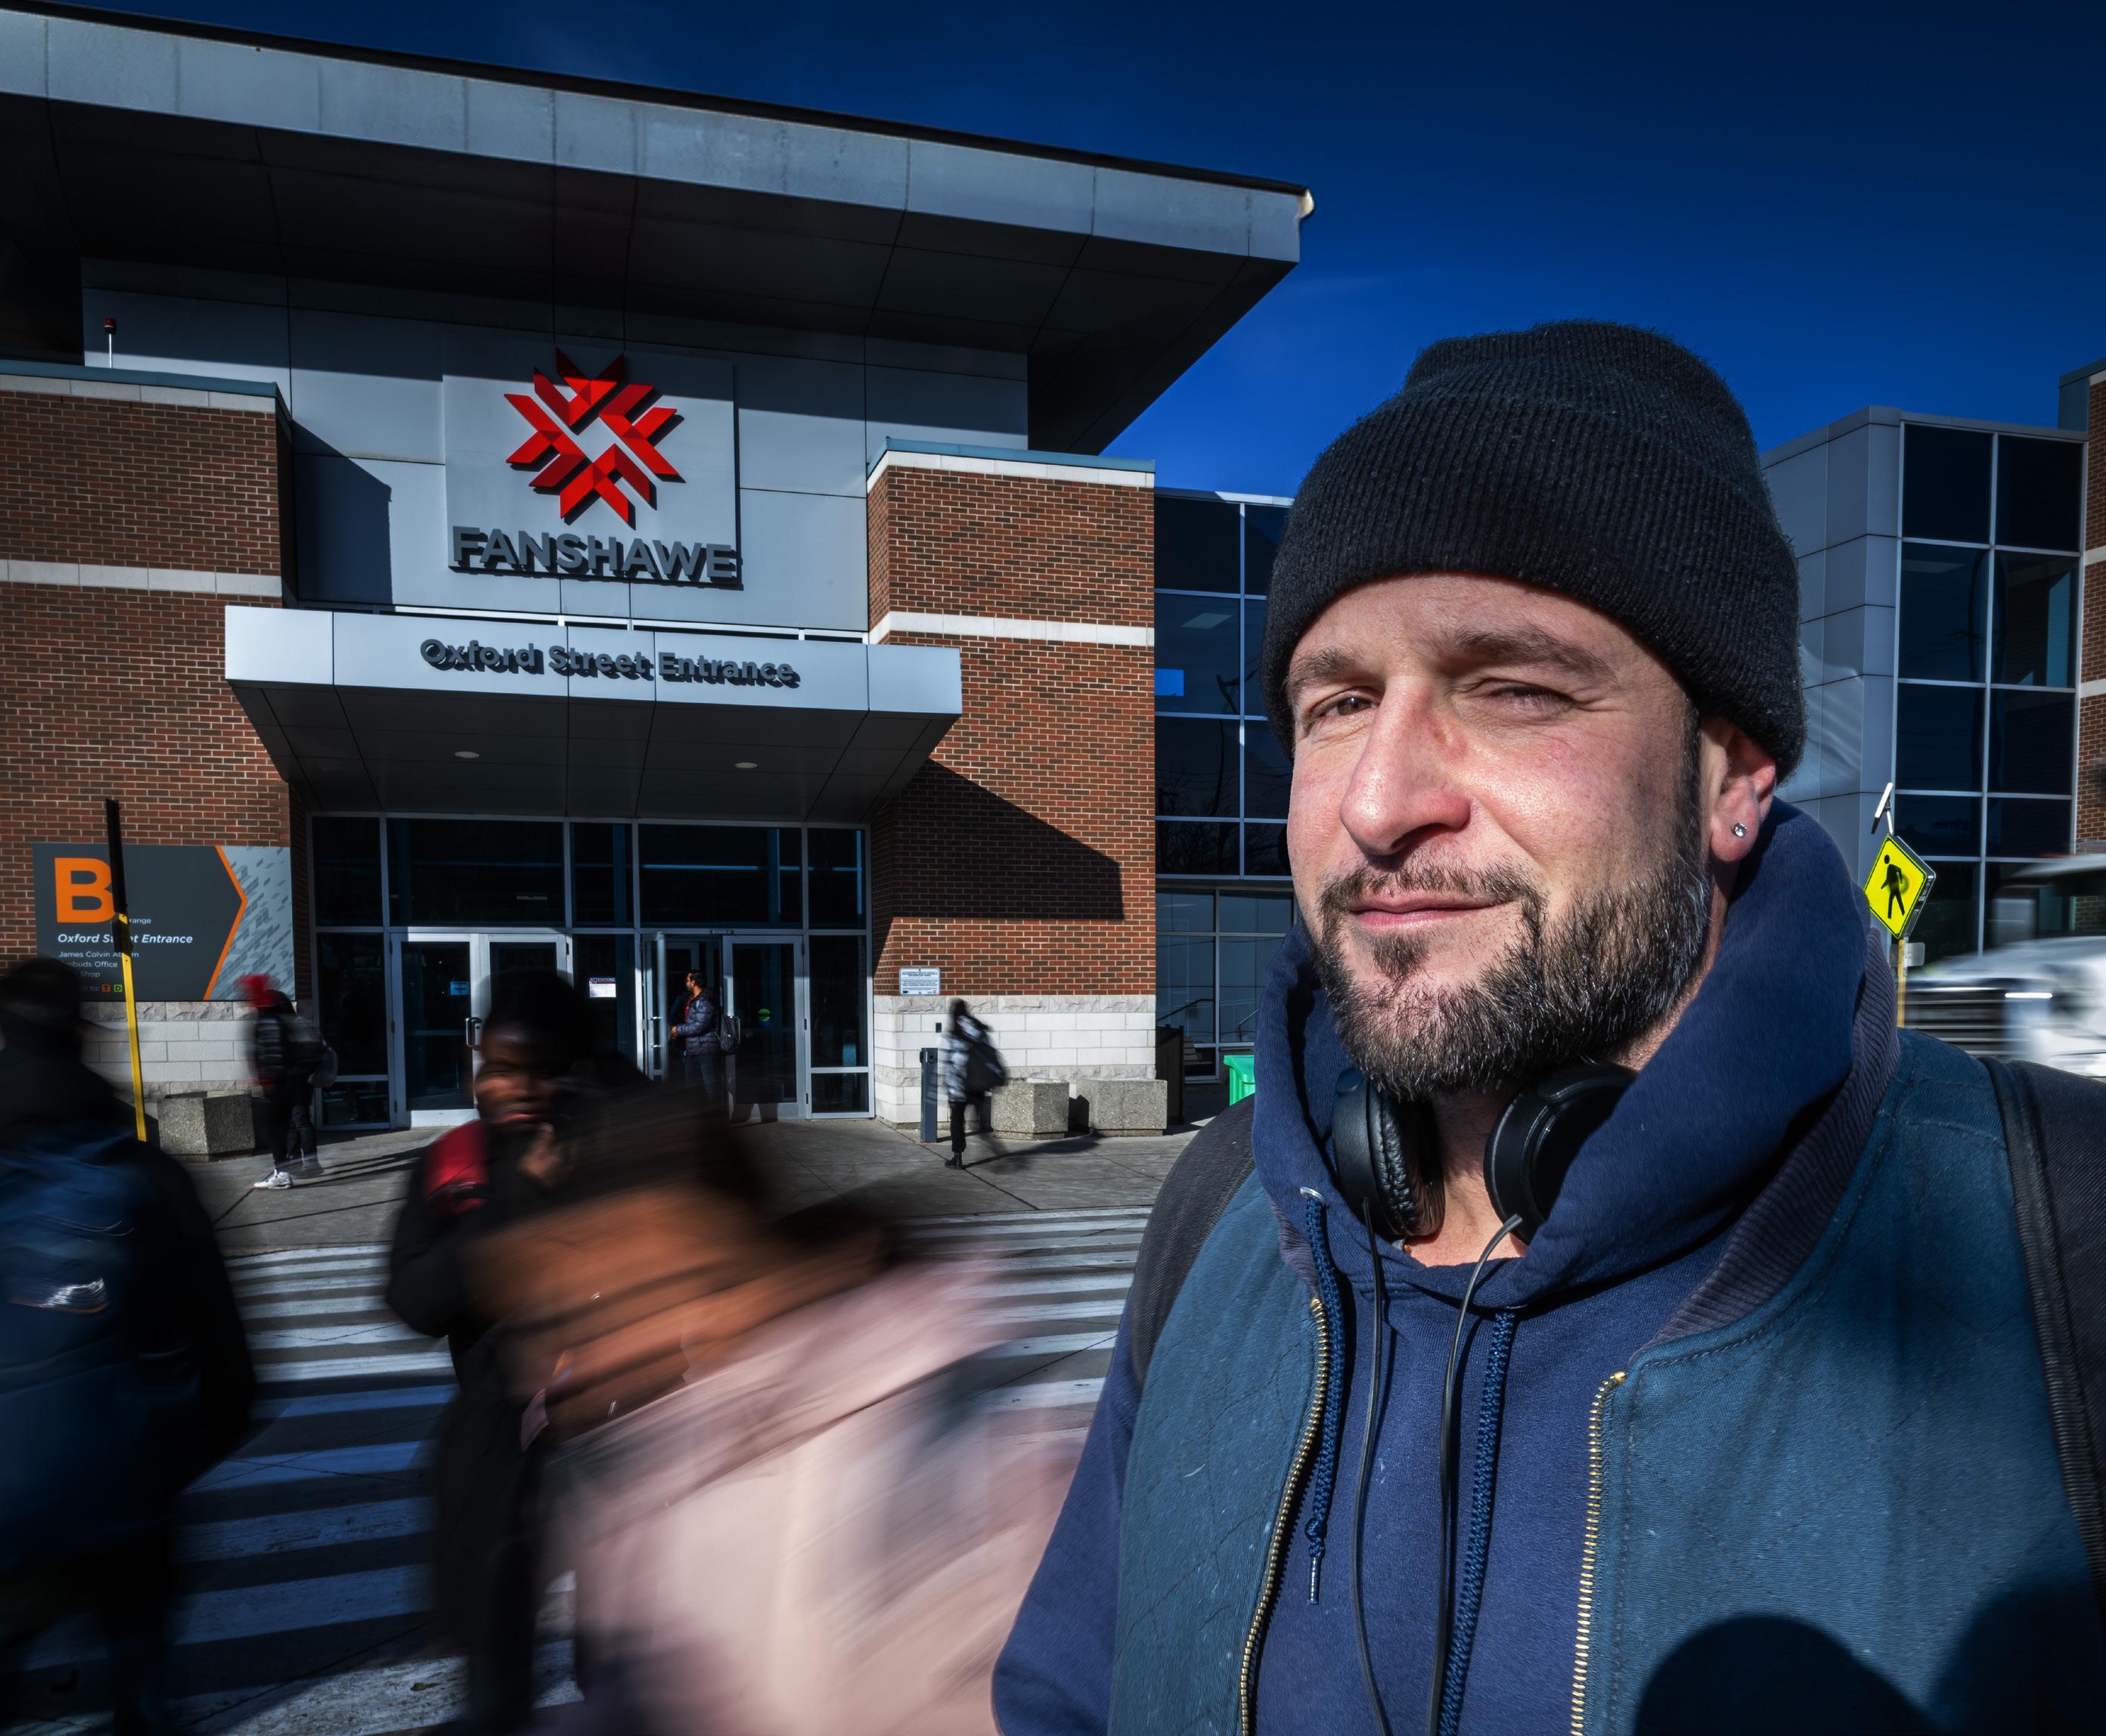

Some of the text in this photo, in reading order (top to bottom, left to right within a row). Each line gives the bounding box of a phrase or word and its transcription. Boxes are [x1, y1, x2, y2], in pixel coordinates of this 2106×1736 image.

[452, 525, 737, 579] FANSHAWE
[420, 638, 796, 683] Oxford Street Entrance
[54, 857, 117, 923] B
[57, 933, 194, 944] Oxford Stt Entrance
